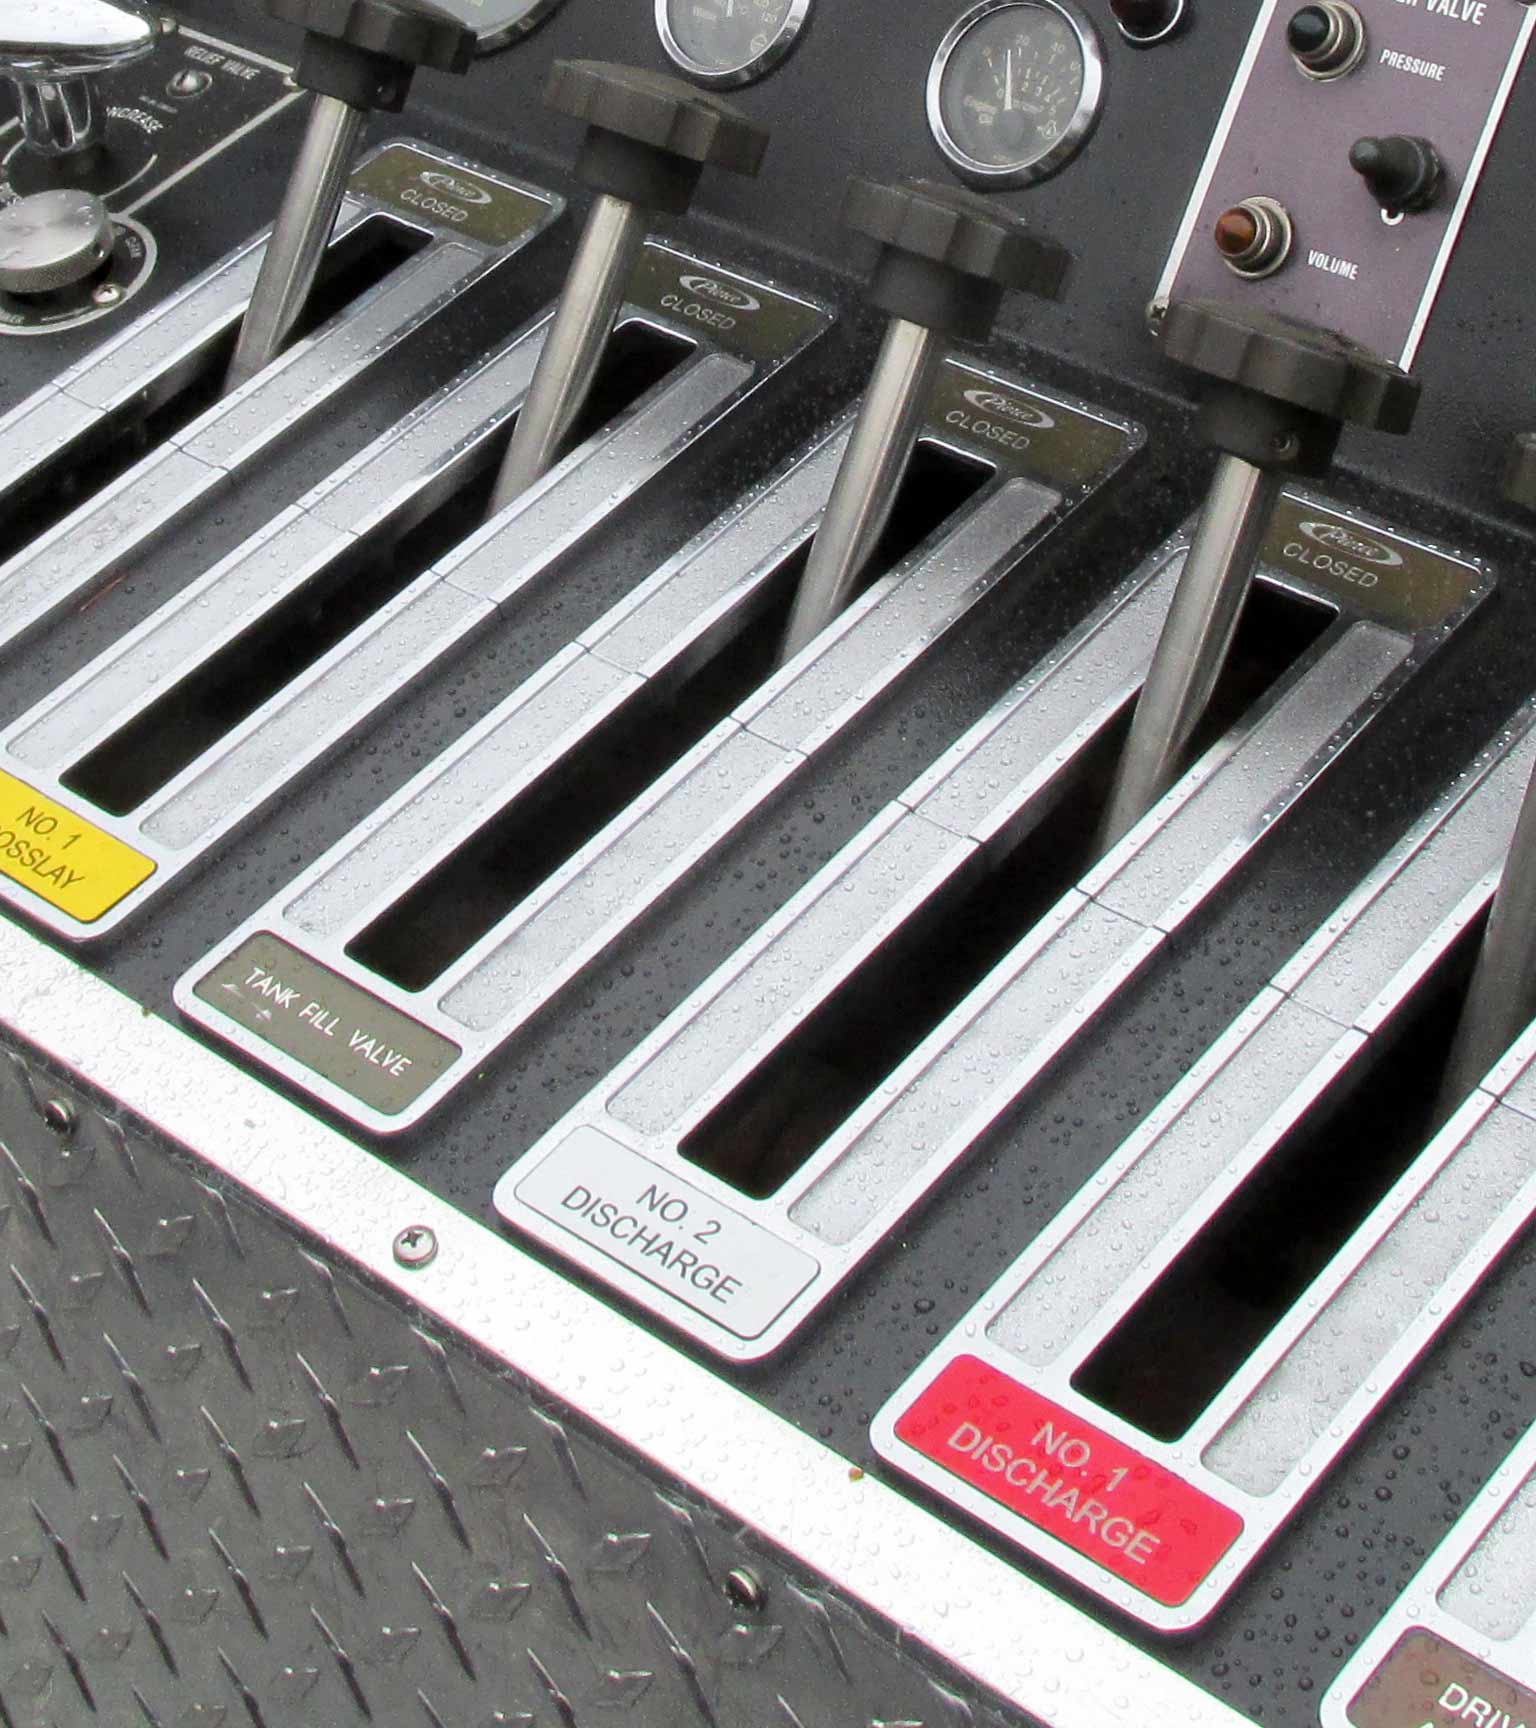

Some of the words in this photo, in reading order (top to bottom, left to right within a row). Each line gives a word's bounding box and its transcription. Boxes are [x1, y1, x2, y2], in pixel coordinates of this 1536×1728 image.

[184, 46, 225, 65] RELIEF
[221, 59, 260, 80] VALVE
[1380, 49, 1447, 82] PRESSURE
[400, 188, 469, 223] CLOSED
[1308, 249, 1359, 281] VOLUME
[660, 294, 737, 332] CLOSED
[945, 410, 1030, 450] CLOSED
[1282, 542, 1379, 590] CLOSED
[14, 804, 62, 846] NO.
[65, 831, 80, 851] 1
[241, 964, 305, 1016] TANK
[296, 996, 342, 1039] FILL
[347, 1026, 415, 1081] VALVE
[635, 1181, 693, 1233] NO.
[698, 1217, 725, 1247] 2
[559, 1185, 746, 1306] DISCHARGE
[1029, 1418, 1093, 1475] NO.
[1108, 1464, 1129, 1495] 1
[945, 1420, 1163, 1568] DISCHARGE
